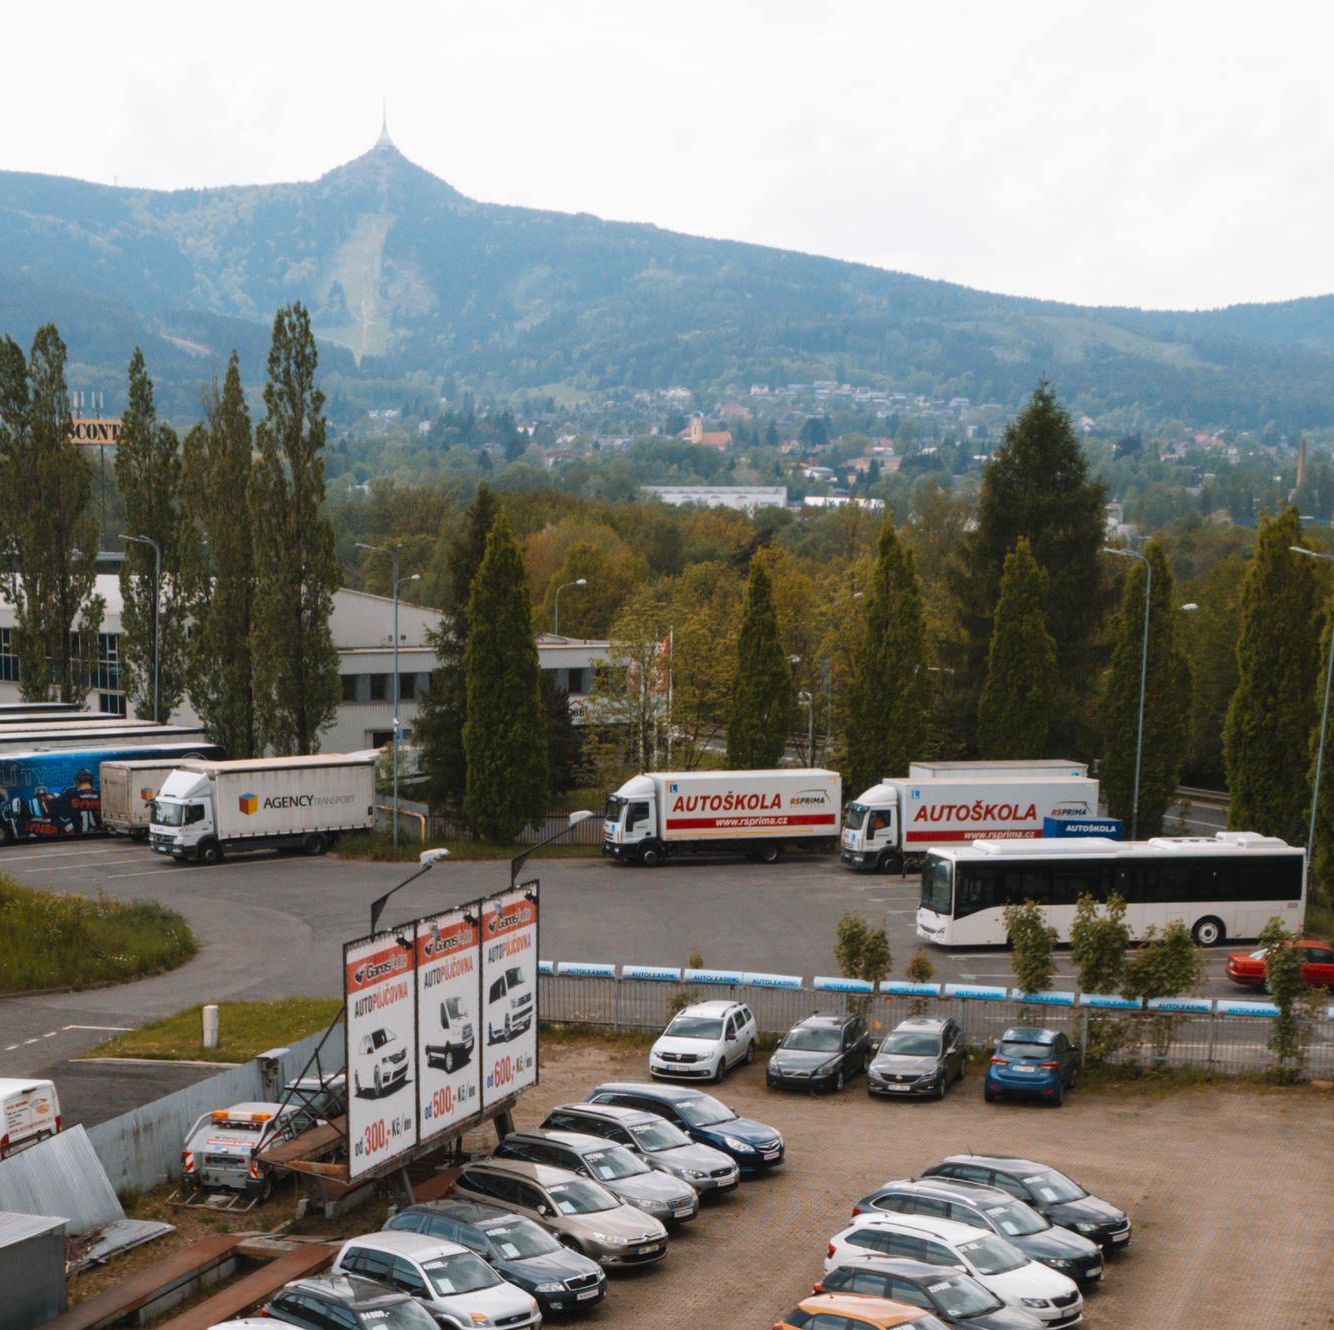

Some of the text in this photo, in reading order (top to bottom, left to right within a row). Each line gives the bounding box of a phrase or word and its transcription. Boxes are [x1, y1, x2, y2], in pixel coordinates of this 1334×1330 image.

[263, 794, 314, 809] AGENCY
[672, 791, 782, 812] AUTOŠKOLA
[914, 800, 1037, 822] AUTOŠKOLA
[715, 816, 789, 827] www.rsprima.cz
[1066, 824, 1116, 833] AUTOŠKOLA
[487, 1075, 494, 1088] od
[424, 1105, 433, 1120] od
[355, 1137, 364, 1156] od
